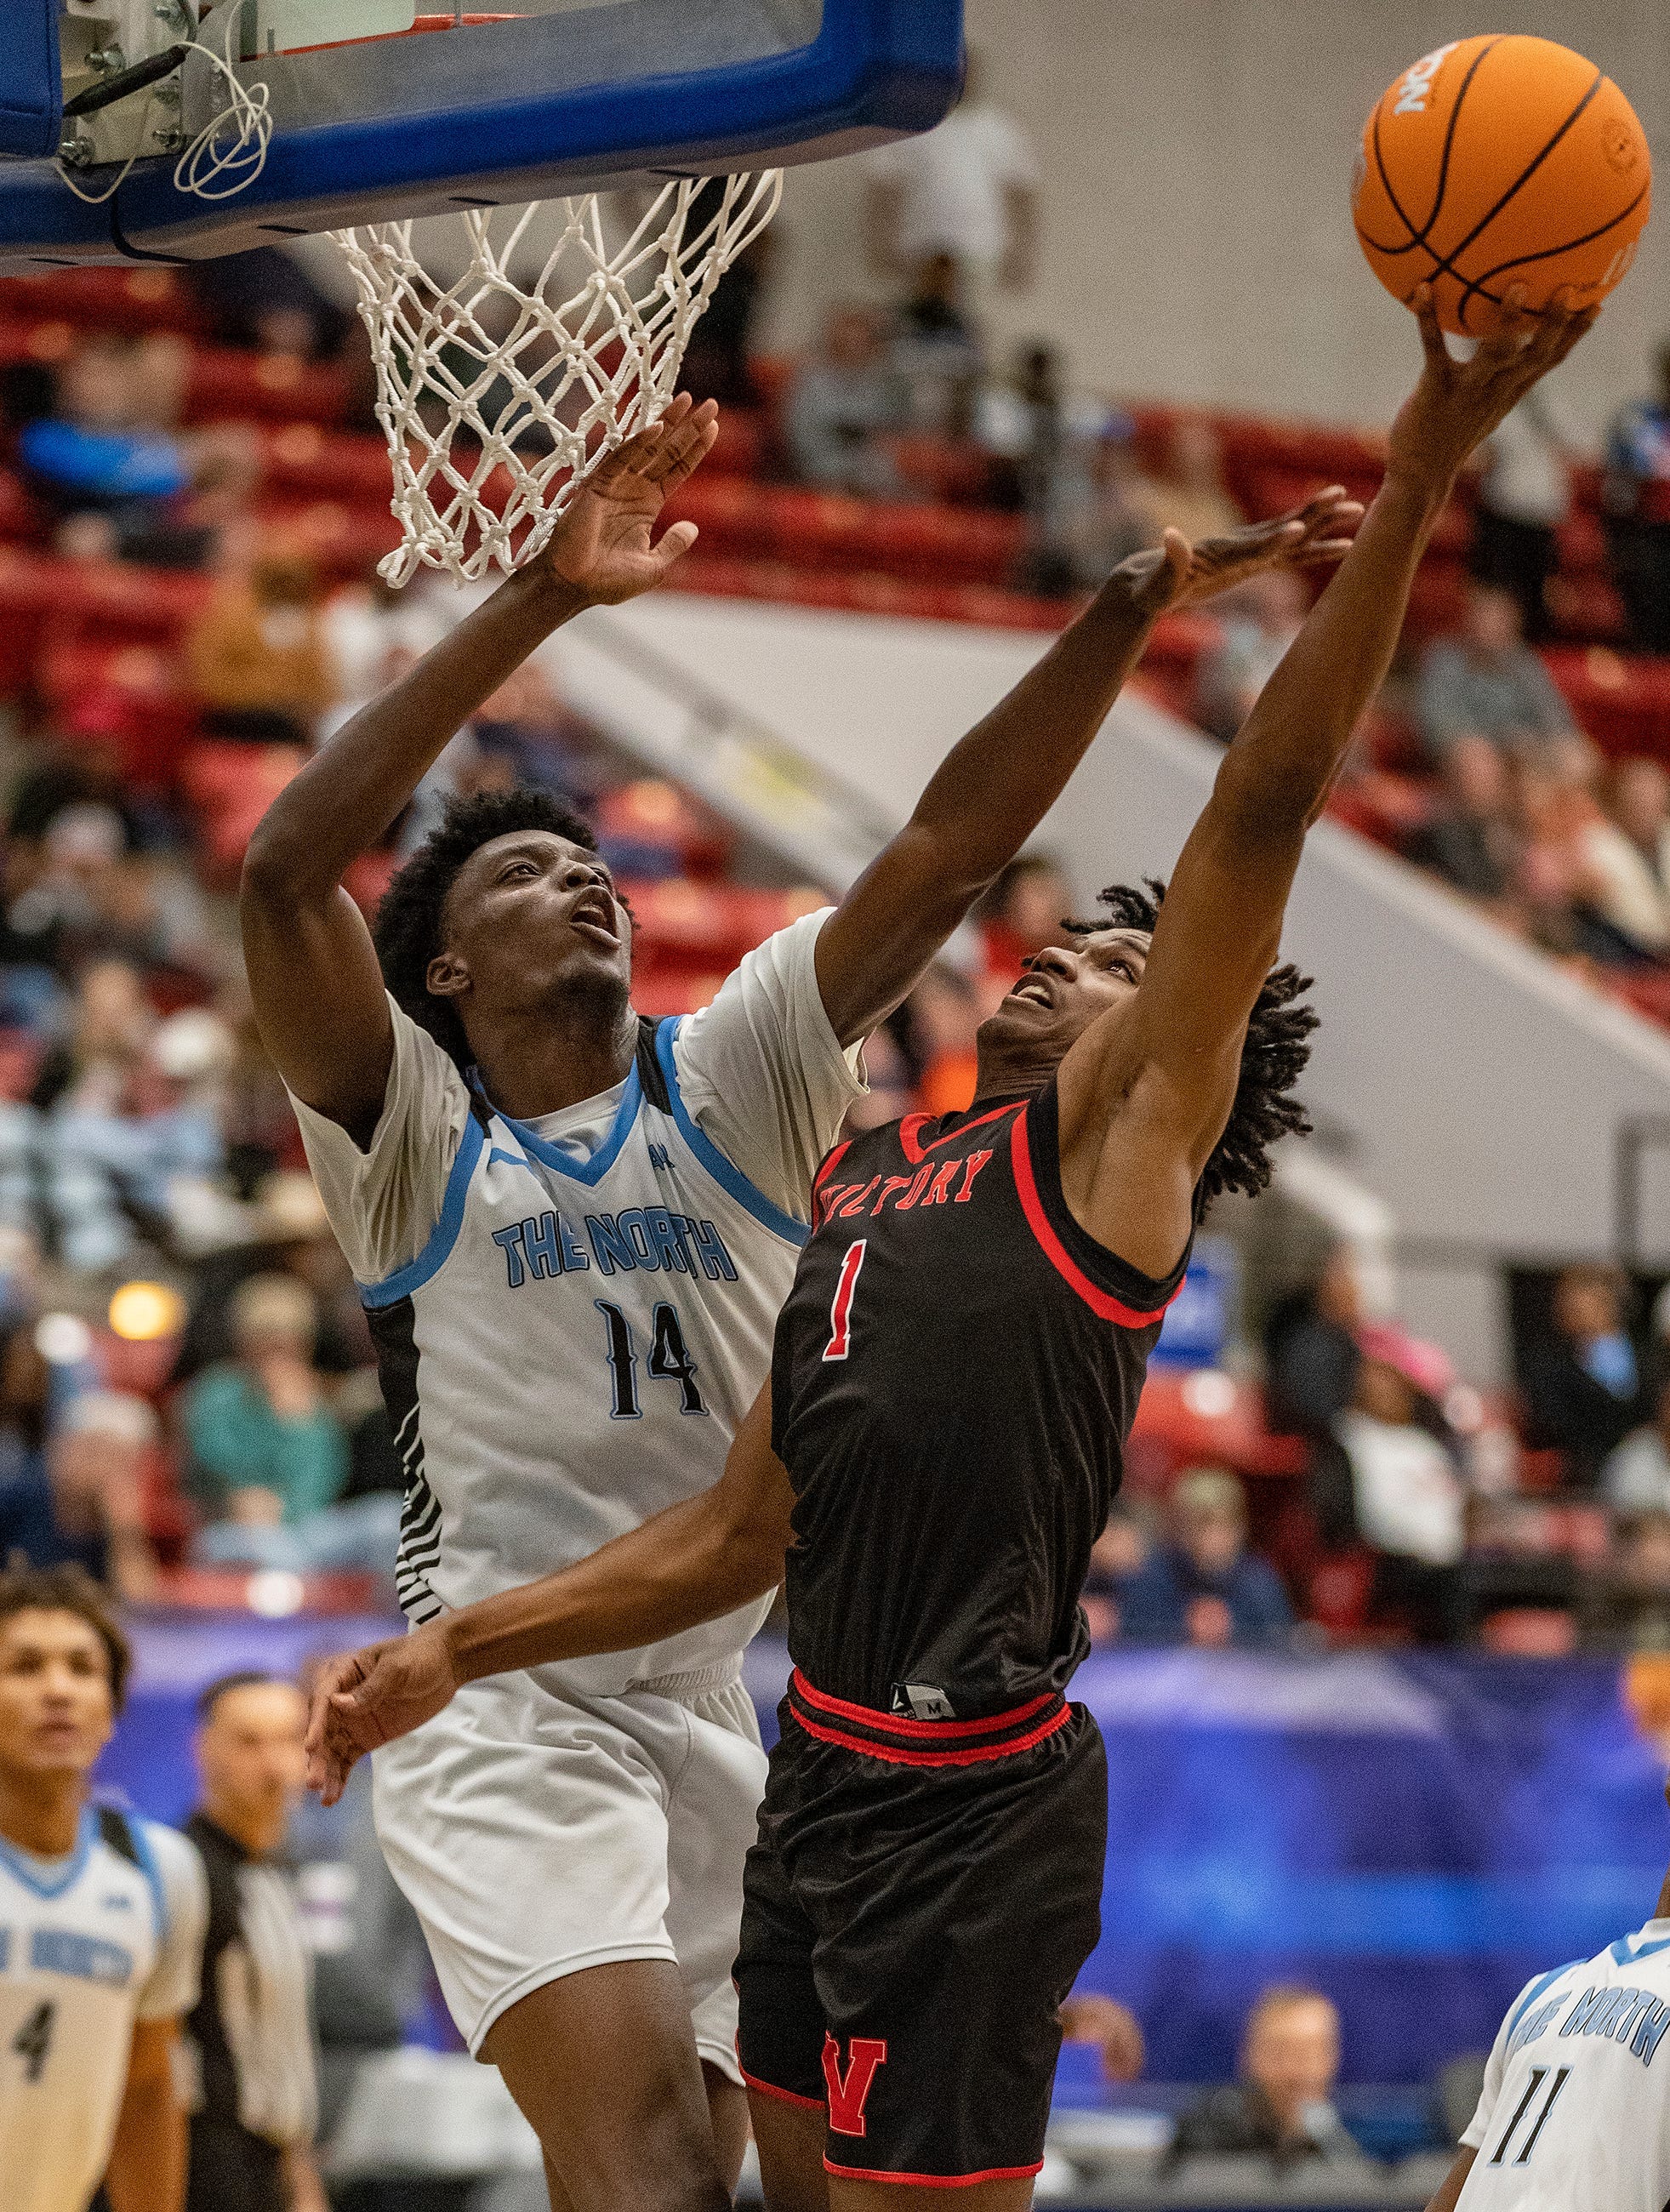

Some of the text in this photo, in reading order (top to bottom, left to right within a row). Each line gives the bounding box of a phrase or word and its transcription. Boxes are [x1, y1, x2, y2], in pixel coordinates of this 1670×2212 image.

[492, 1206, 738, 1288] THE NORTH
[822, 1239, 867, 1361] 1
[594, 1298, 710, 1419] 14
[11, 1998, 57, 2084] 4
[1559, 1986, 1670, 2067] NORTH
[821, 2029, 887, 2137] V
[1486, 2063, 1574, 2167] 11
